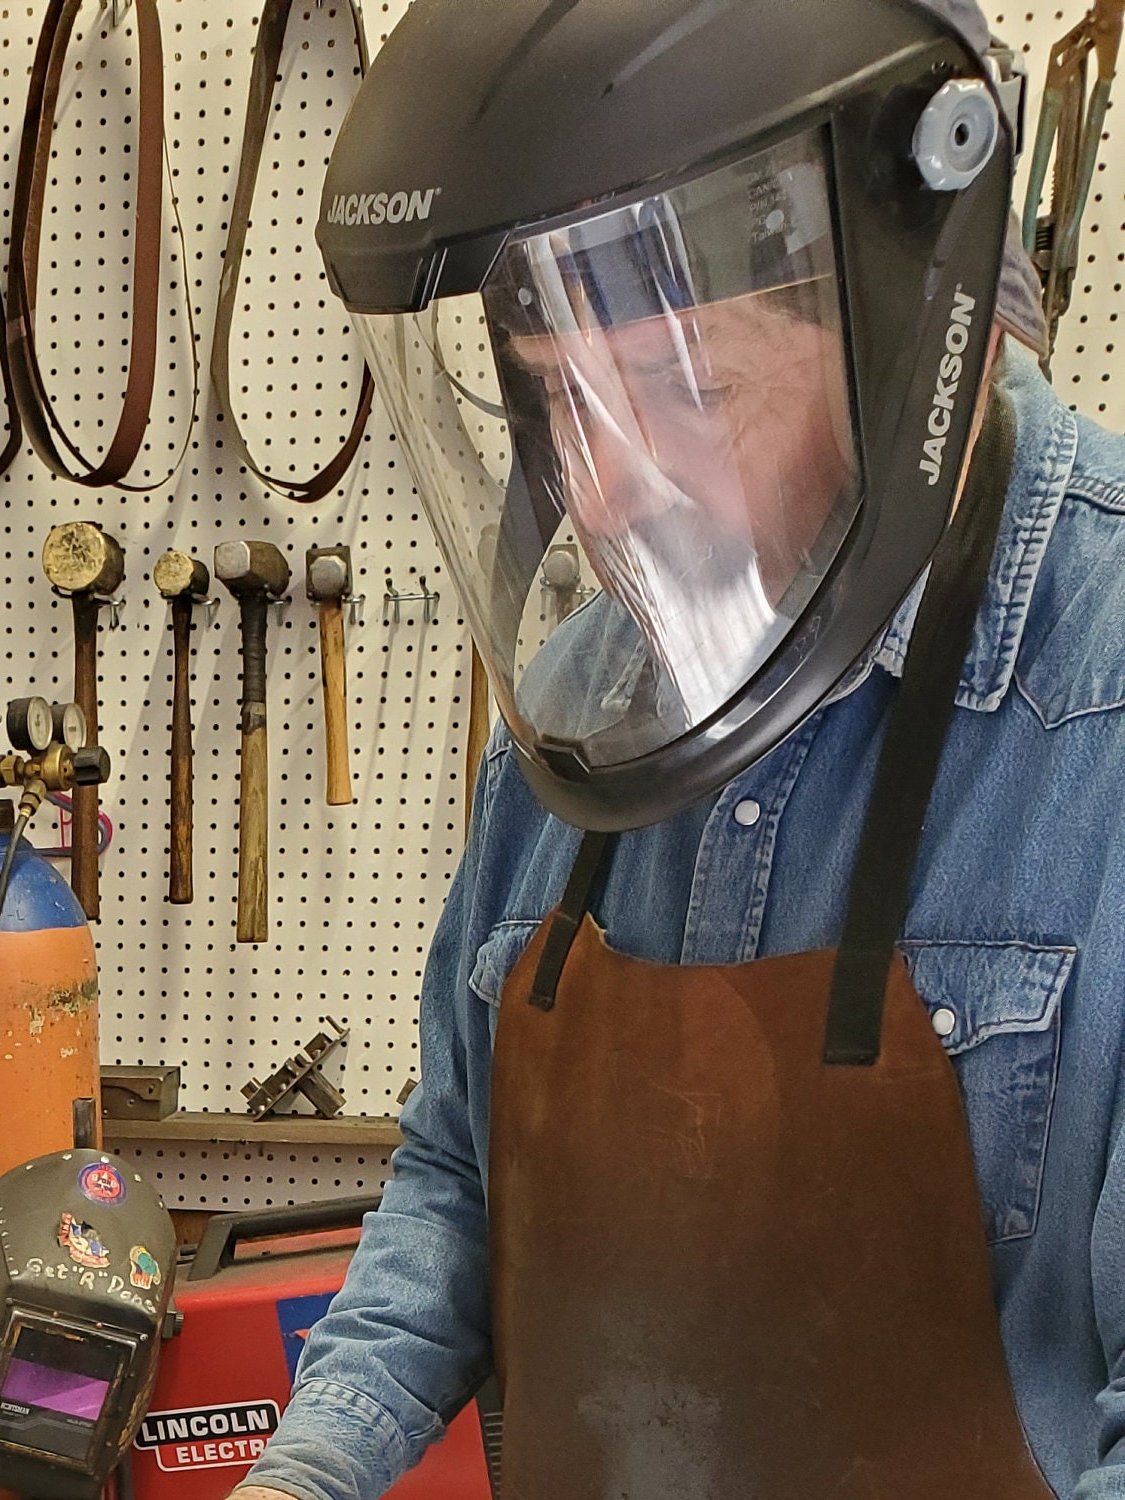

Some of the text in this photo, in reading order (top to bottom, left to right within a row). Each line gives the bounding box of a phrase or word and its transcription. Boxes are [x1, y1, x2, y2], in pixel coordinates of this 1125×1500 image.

[327, 188, 435, 226] JACKSON
[919, 291, 975, 486] JACKSON
[27, 1257, 69, 1280] Get
[141, 1409, 270, 1442] LINCOLN
[175, 1438, 271, 1464] ELECTR
